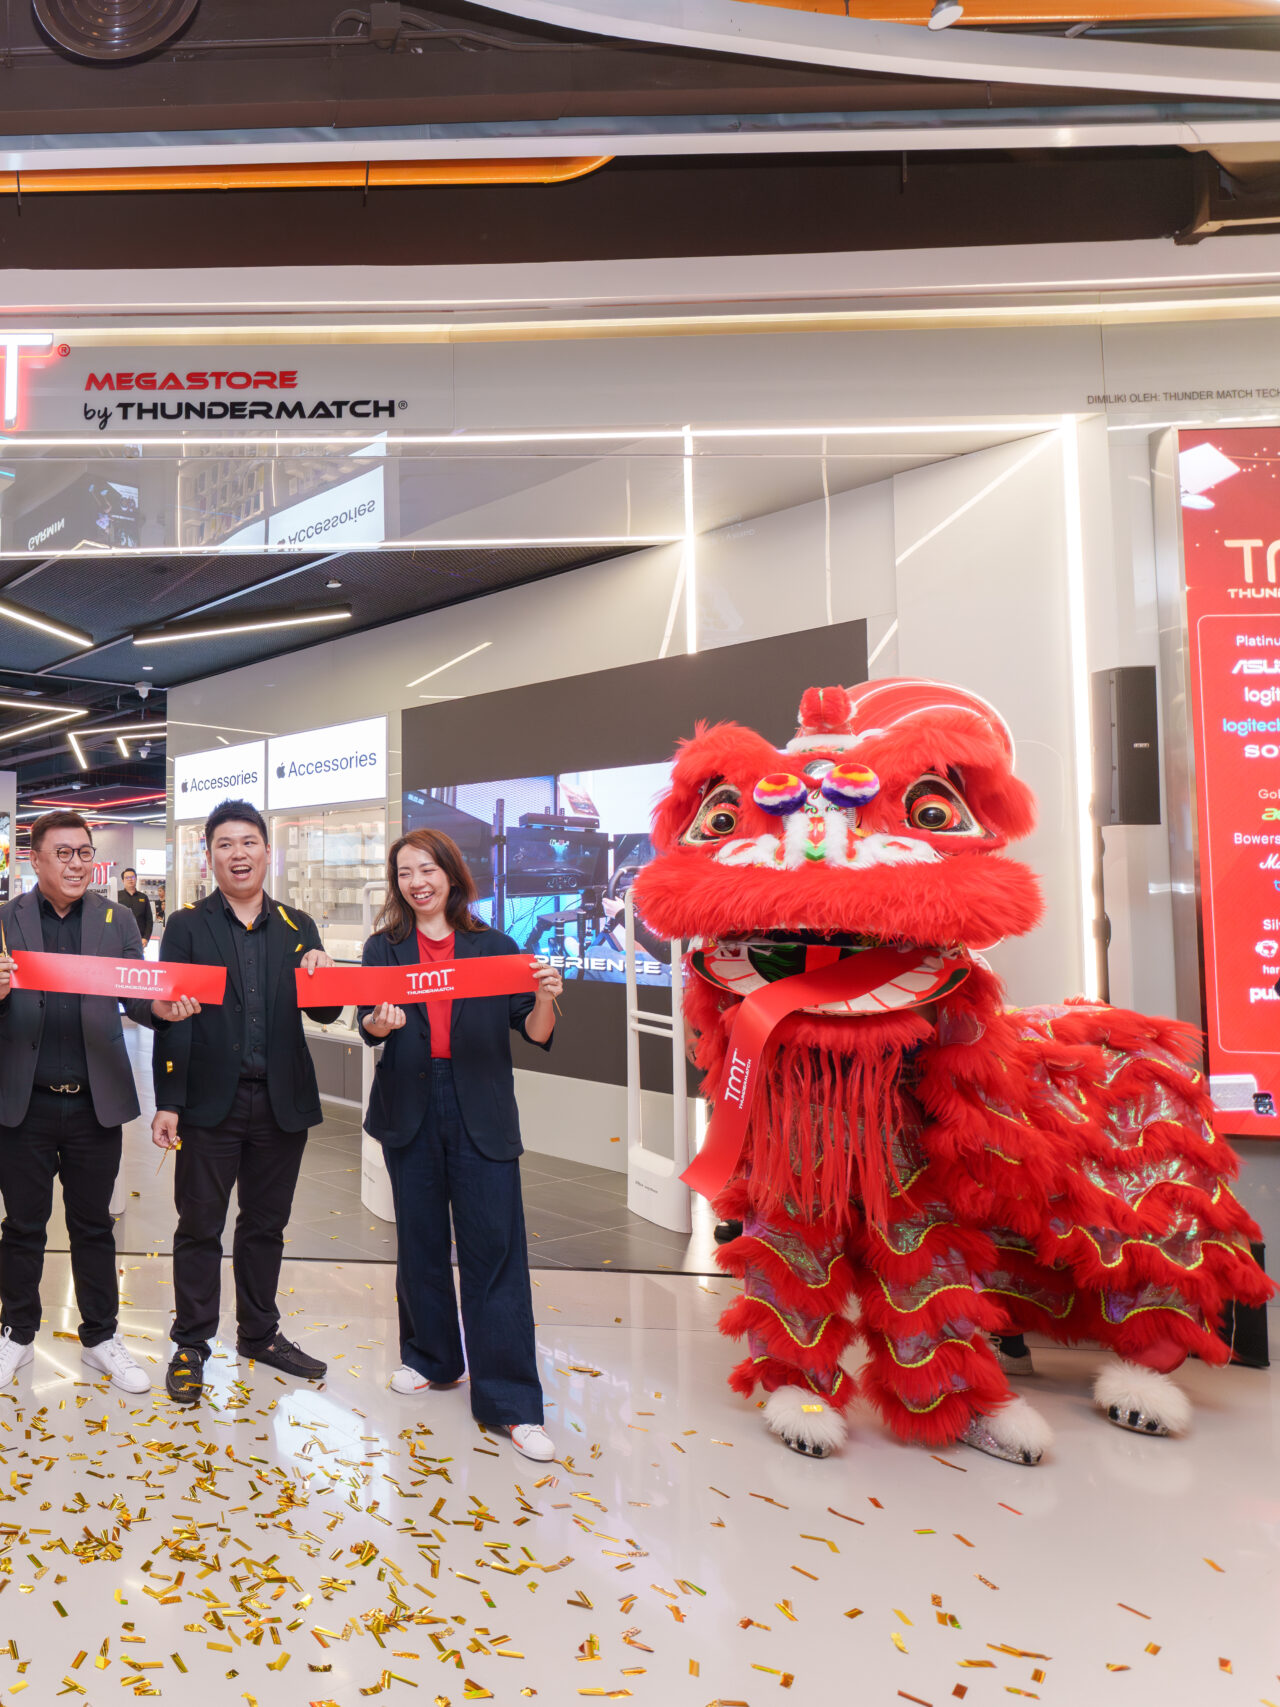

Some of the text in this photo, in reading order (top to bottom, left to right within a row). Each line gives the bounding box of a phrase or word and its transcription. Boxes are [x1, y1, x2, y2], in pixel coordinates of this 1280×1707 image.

[84, 370, 298, 391] MEGASTORE
[1087, 393, 1126, 404] DIMILIKI
[1163, 390, 1214, 401] THUNDER
[1216, 389, 1253, 400] MATCH
[84, 402, 112, 430] by
[1227, 588, 1280, 599] THUN
[1232, 659, 1280, 674] ASU
[1244, 744, 1280, 758] SO
[288, 751, 377, 778] Accessories
[190, 769, 258, 793] Accessories
[407, 986, 455, 995] THUNDERMATCH
